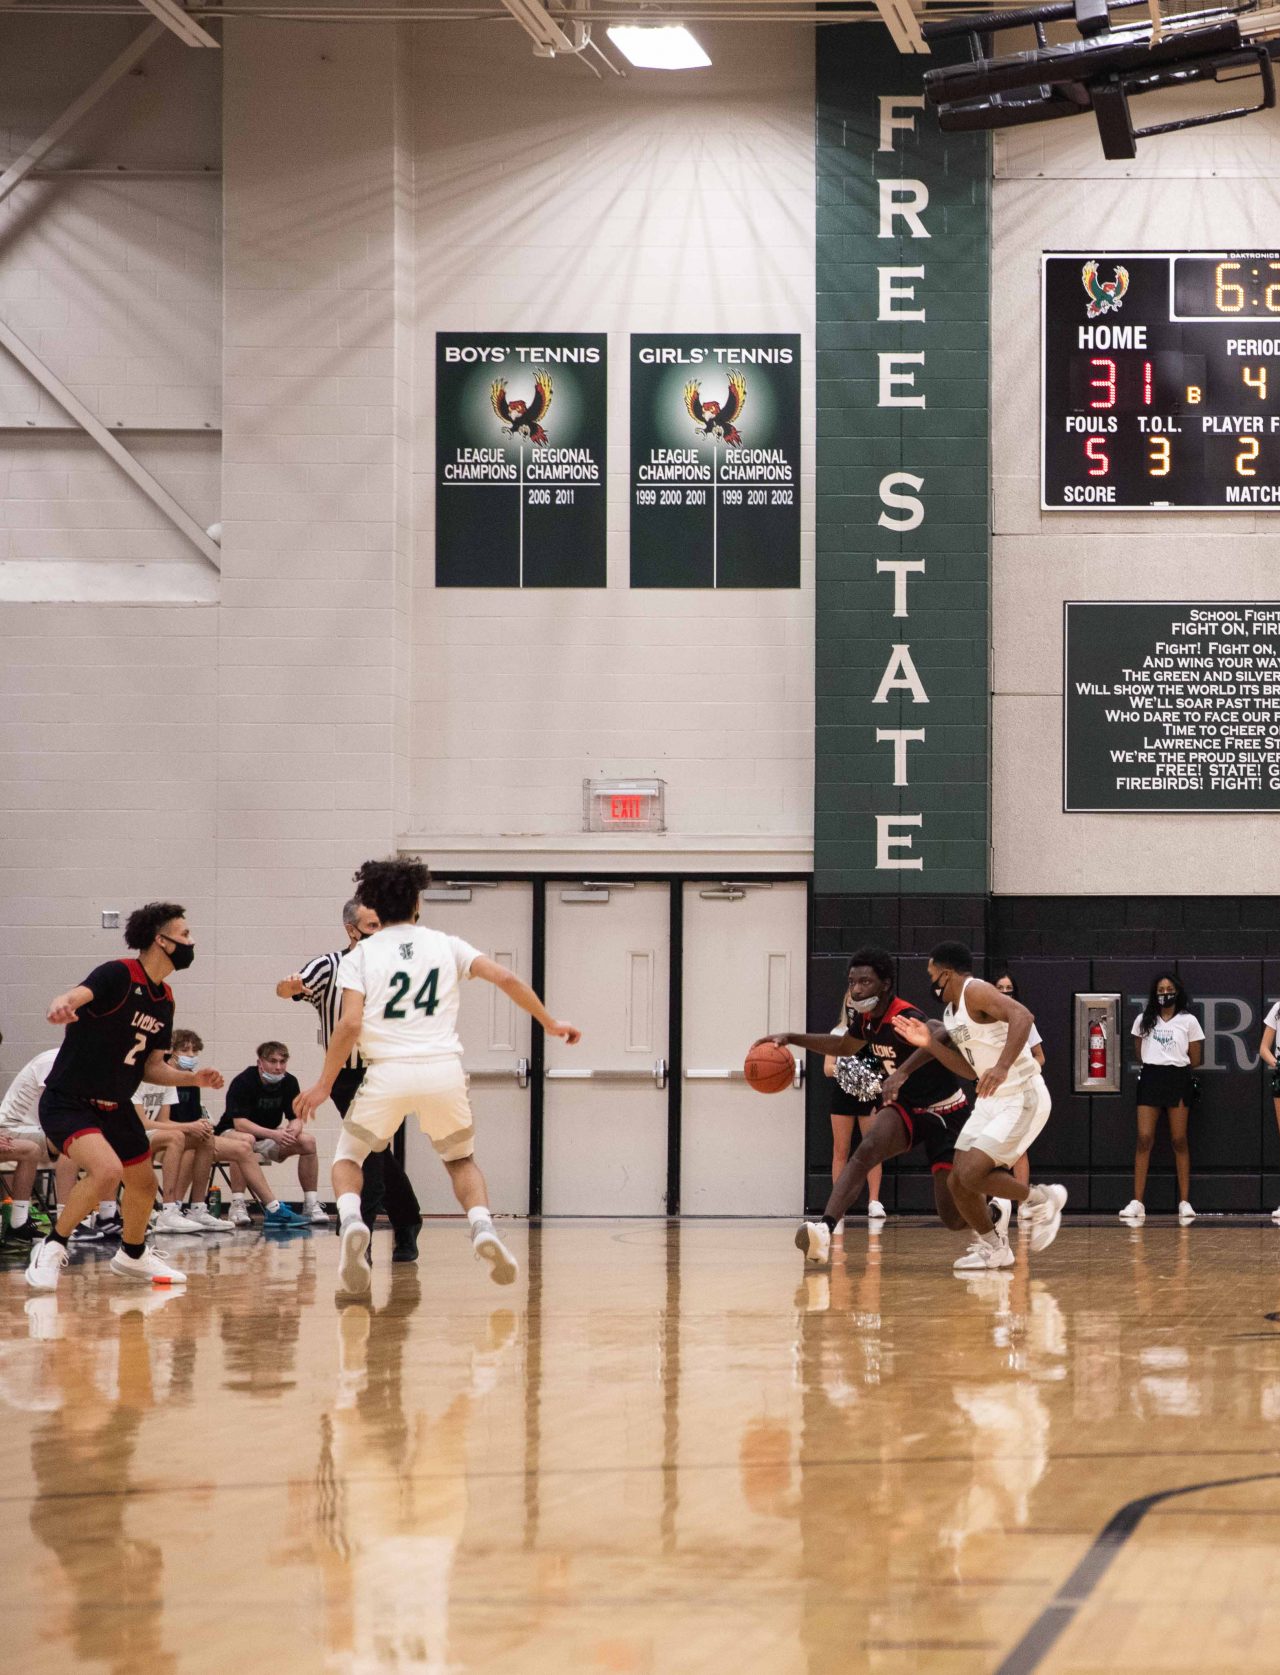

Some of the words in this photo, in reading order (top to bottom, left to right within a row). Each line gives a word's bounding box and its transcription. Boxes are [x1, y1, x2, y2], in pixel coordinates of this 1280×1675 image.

[877, 95, 931, 410] FREE
[1078, 325, 1148, 350] HOME
[446, 347, 510, 363] BOYS'
[516, 348, 600, 363] TENNIS
[639, 348, 708, 364] GIRLS'
[713, 348, 793, 364] TENNIS
[1091, 359, 1152, 409] 31
[1242, 366, 1267, 400] 4
[1065, 416, 1118, 433] FOULS
[1137, 416, 1182, 433] T.O.L.
[1202, 416, 1264, 433] PLAYER
[457, 448, 505, 463] LEAGUE
[531, 449, 594, 464] REGIONAL
[650, 449, 699, 464] LEAGUE
[725, 449, 788, 464] REGIONAL
[1085, 437, 1109, 475] 5
[1149, 436, 1171, 476] 3
[445, 464, 517, 480] CHAMPIONS
[526, 464, 599, 480] CHAMPIONS
[639, 465, 711, 481] CHAMPIONS
[720, 465, 792, 481] CHAMPIONS
[528, 489, 551, 505] 2006
[555, 489, 575, 505] 2011
[636, 489, 656, 505] 1999
[660, 489, 682, 505] 2000
[686, 489, 706, 505] 2001
[722, 489, 743, 505] 1999
[748, 489, 768, 505] 2001
[771, 489, 794, 505] 2002
[1063, 486, 1117, 503] SCORE
[872, 472, 930, 871] STATE
[611, 795, 641, 818] EXIT
[383, 967, 440, 1019] 24
[131, 1011, 165, 1034] LIONS
[124, 1032, 147, 1066] 2
[871, 1043, 897, 1059] LIONS
